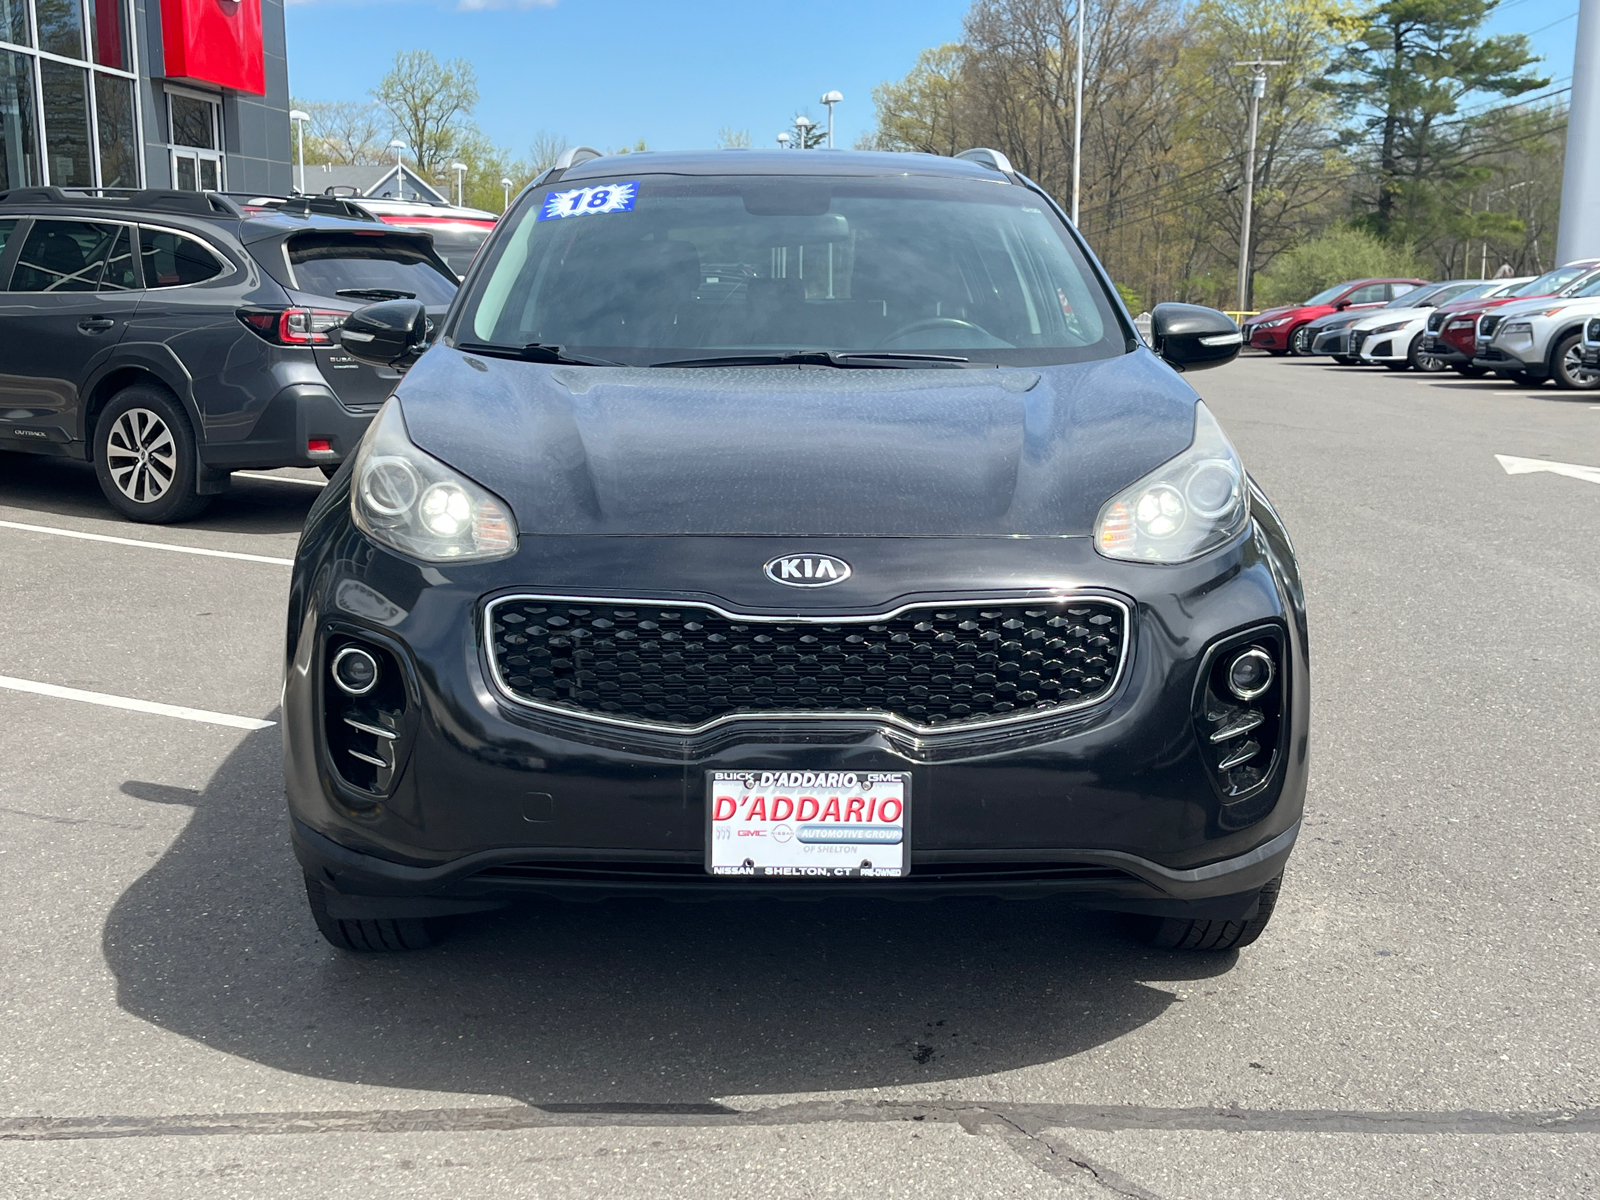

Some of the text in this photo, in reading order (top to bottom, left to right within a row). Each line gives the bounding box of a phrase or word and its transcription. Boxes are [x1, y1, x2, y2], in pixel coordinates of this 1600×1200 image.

[568, 189, 611, 211] 18
[14, 429, 46, 437] OUTBACK
[780, 558, 838, 578] KIA
[714, 772, 902, 788] BUICK D'ADDARIO GMC
[712, 795, 903, 823] D'ADDARIO
[737, 829, 768, 837] GMC
[801, 829, 899, 839] AUTOMOTIVE GROUP
[803, 845, 858, 854] OF SHELTON
[713, 866, 902, 877] NISSAN SHELTON, CT PRE-OWNED
